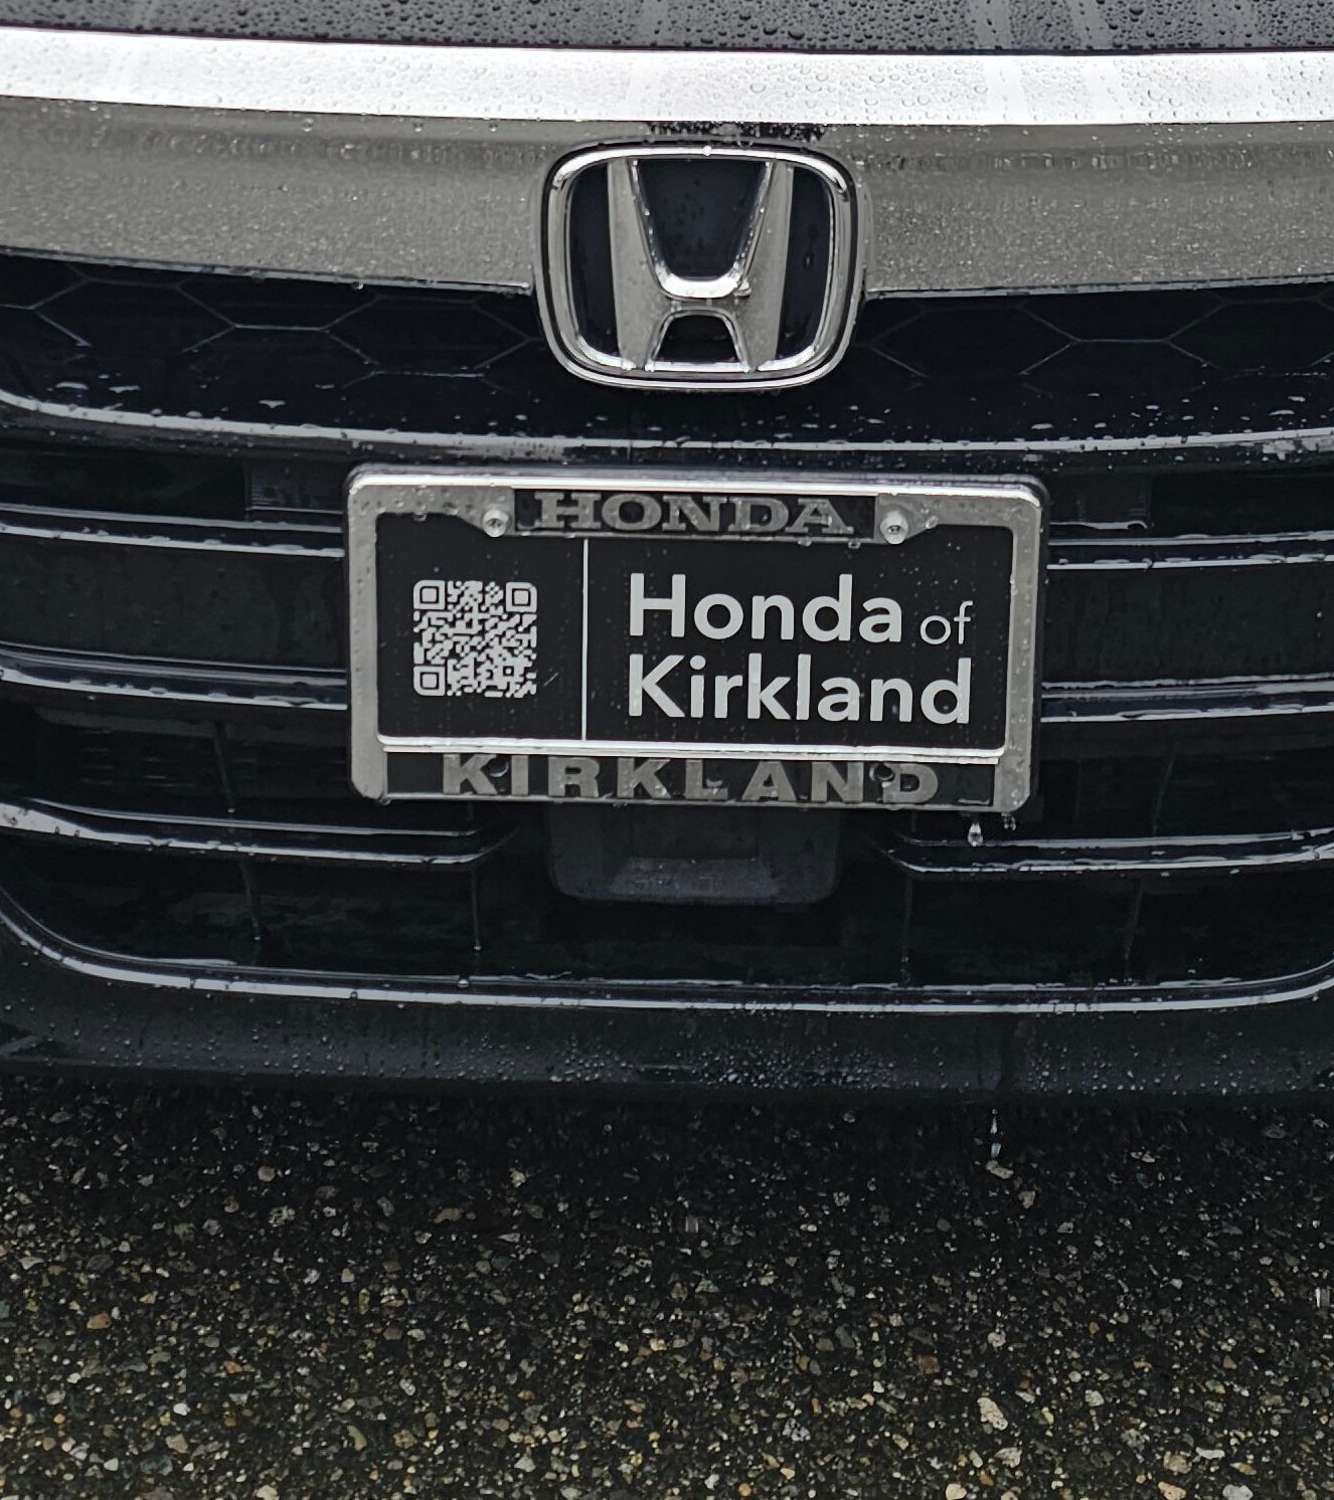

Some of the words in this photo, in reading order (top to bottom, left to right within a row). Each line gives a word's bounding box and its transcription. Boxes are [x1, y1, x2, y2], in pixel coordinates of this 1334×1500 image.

[534, 490, 855, 535] HONDA
[629, 572, 903, 642] Honda
[920, 600, 974, 645] of
[628, 652, 972, 724] Kirkland
[443, 753, 939, 804] KIRKLAND
